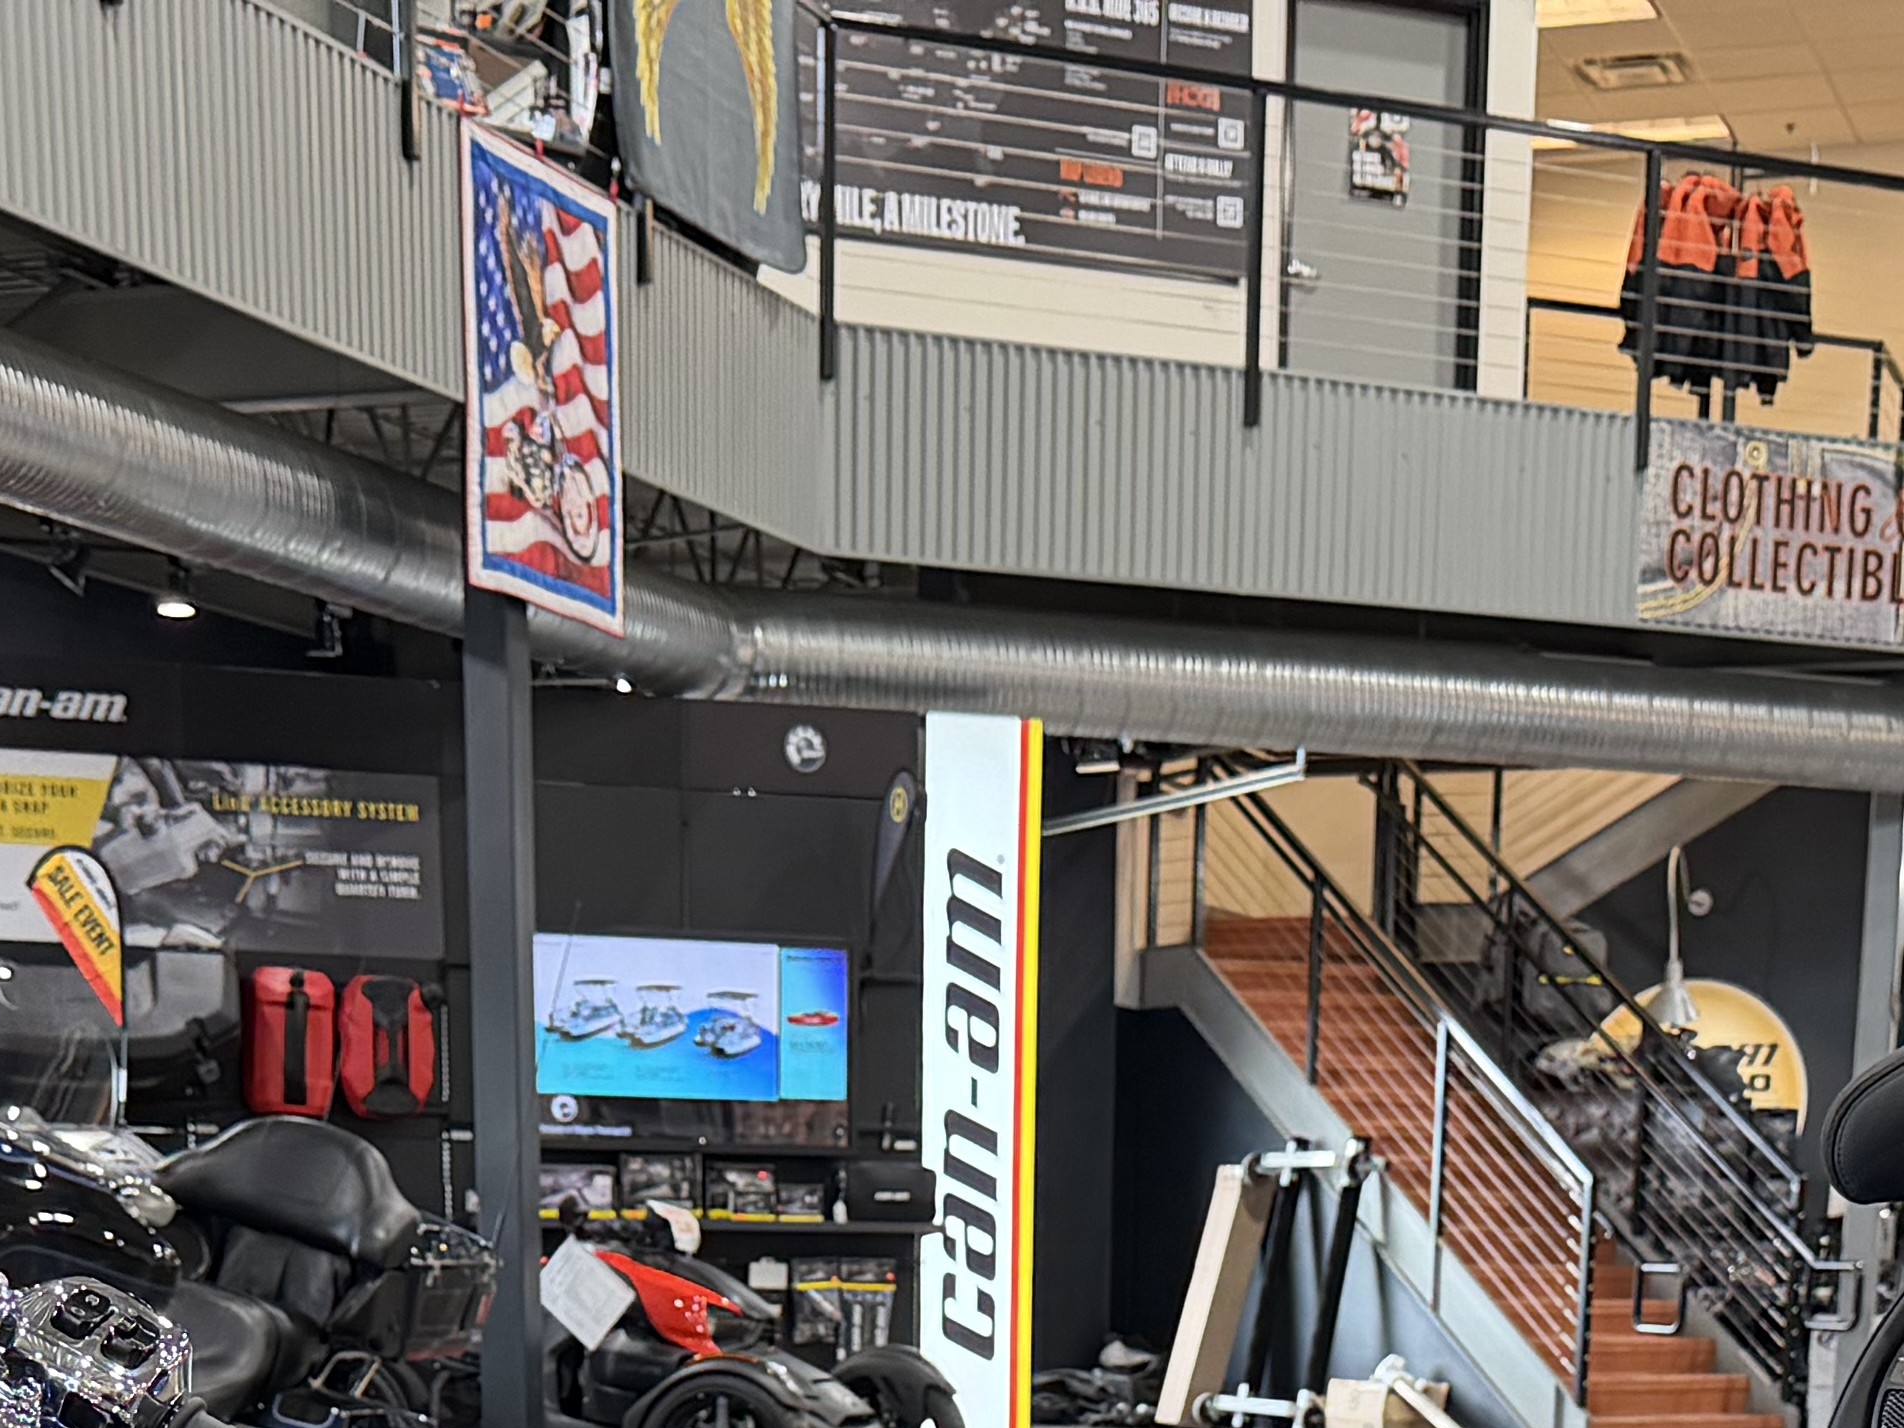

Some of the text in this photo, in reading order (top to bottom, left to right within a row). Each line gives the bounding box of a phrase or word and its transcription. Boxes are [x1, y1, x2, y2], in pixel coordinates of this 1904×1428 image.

[901, 193, 1026, 246] MILESTONE.
[1671, 463, 1872, 538] CLOTHING
[357, 800, 420, 822] SYSTEM
[47, 864, 84, 909] SALE
[73, 904, 115, 956] EVENT
[942, 848, 1003, 1361] can-am
